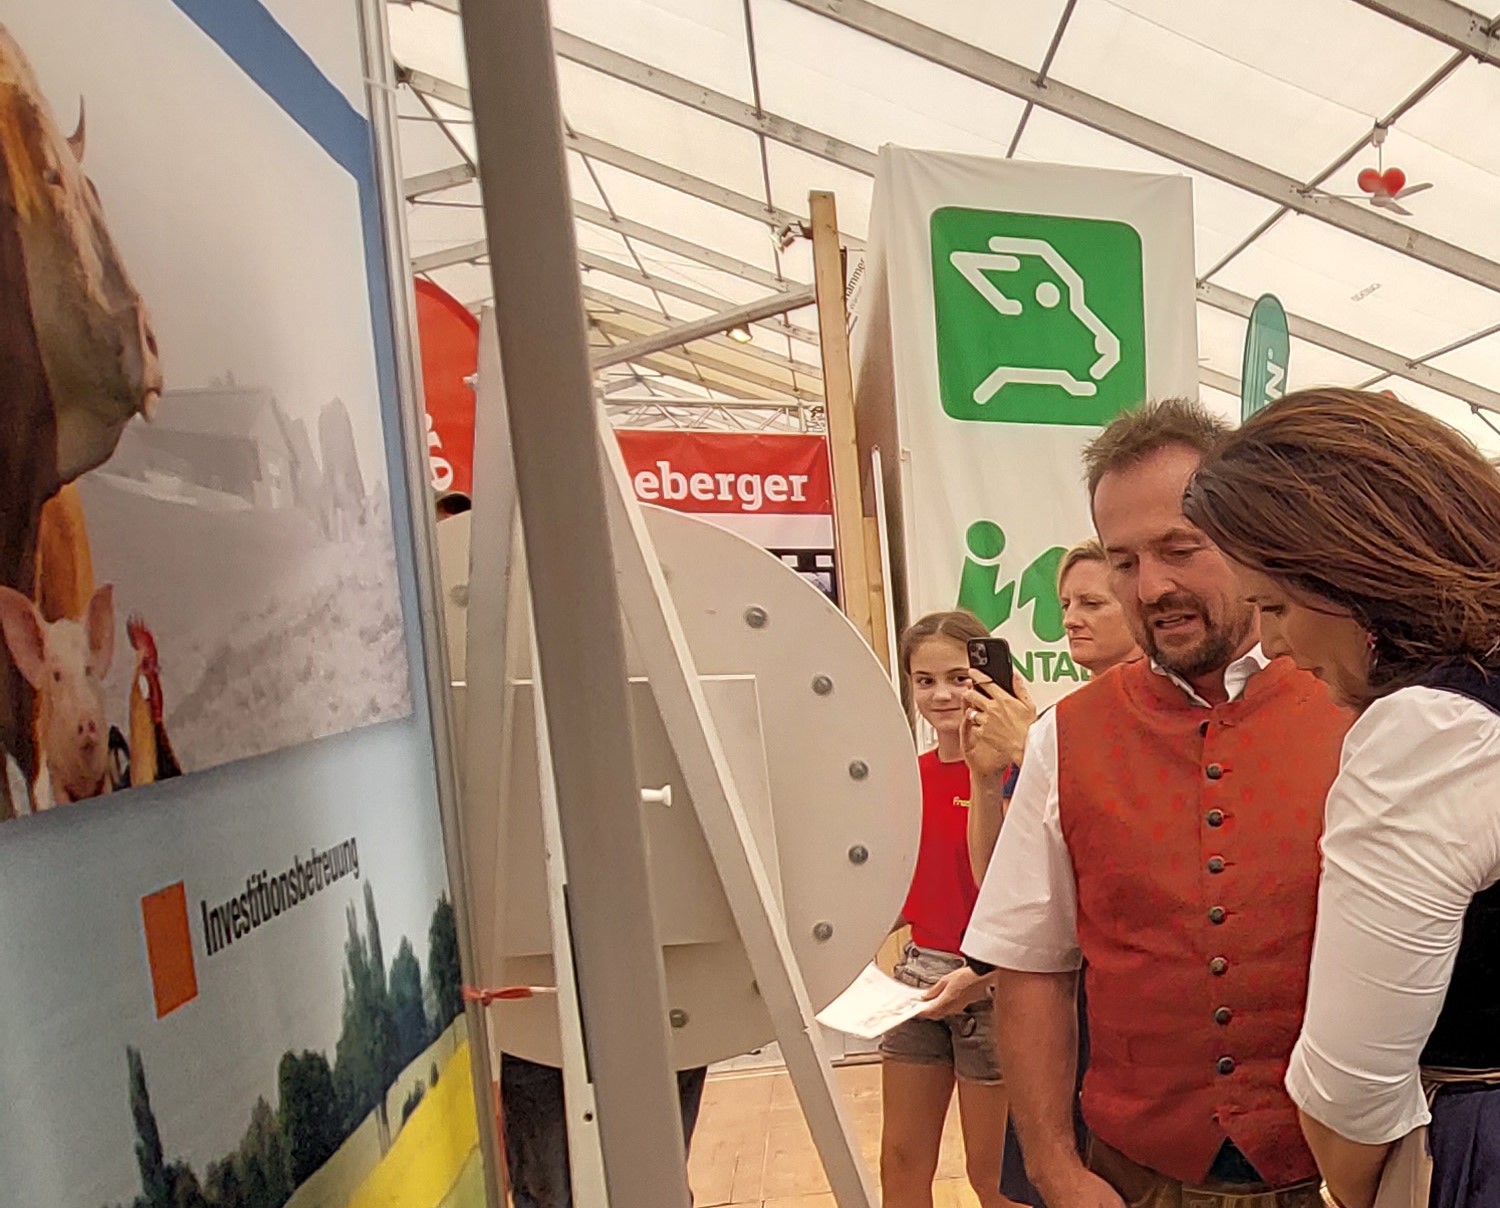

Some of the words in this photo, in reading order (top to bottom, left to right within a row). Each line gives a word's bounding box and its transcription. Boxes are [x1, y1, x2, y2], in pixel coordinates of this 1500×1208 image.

[634, 461, 808, 511] eberger
[1011, 651, 1091, 683] NTA
[201, 837, 360, 957] Investitionsbetreuung
